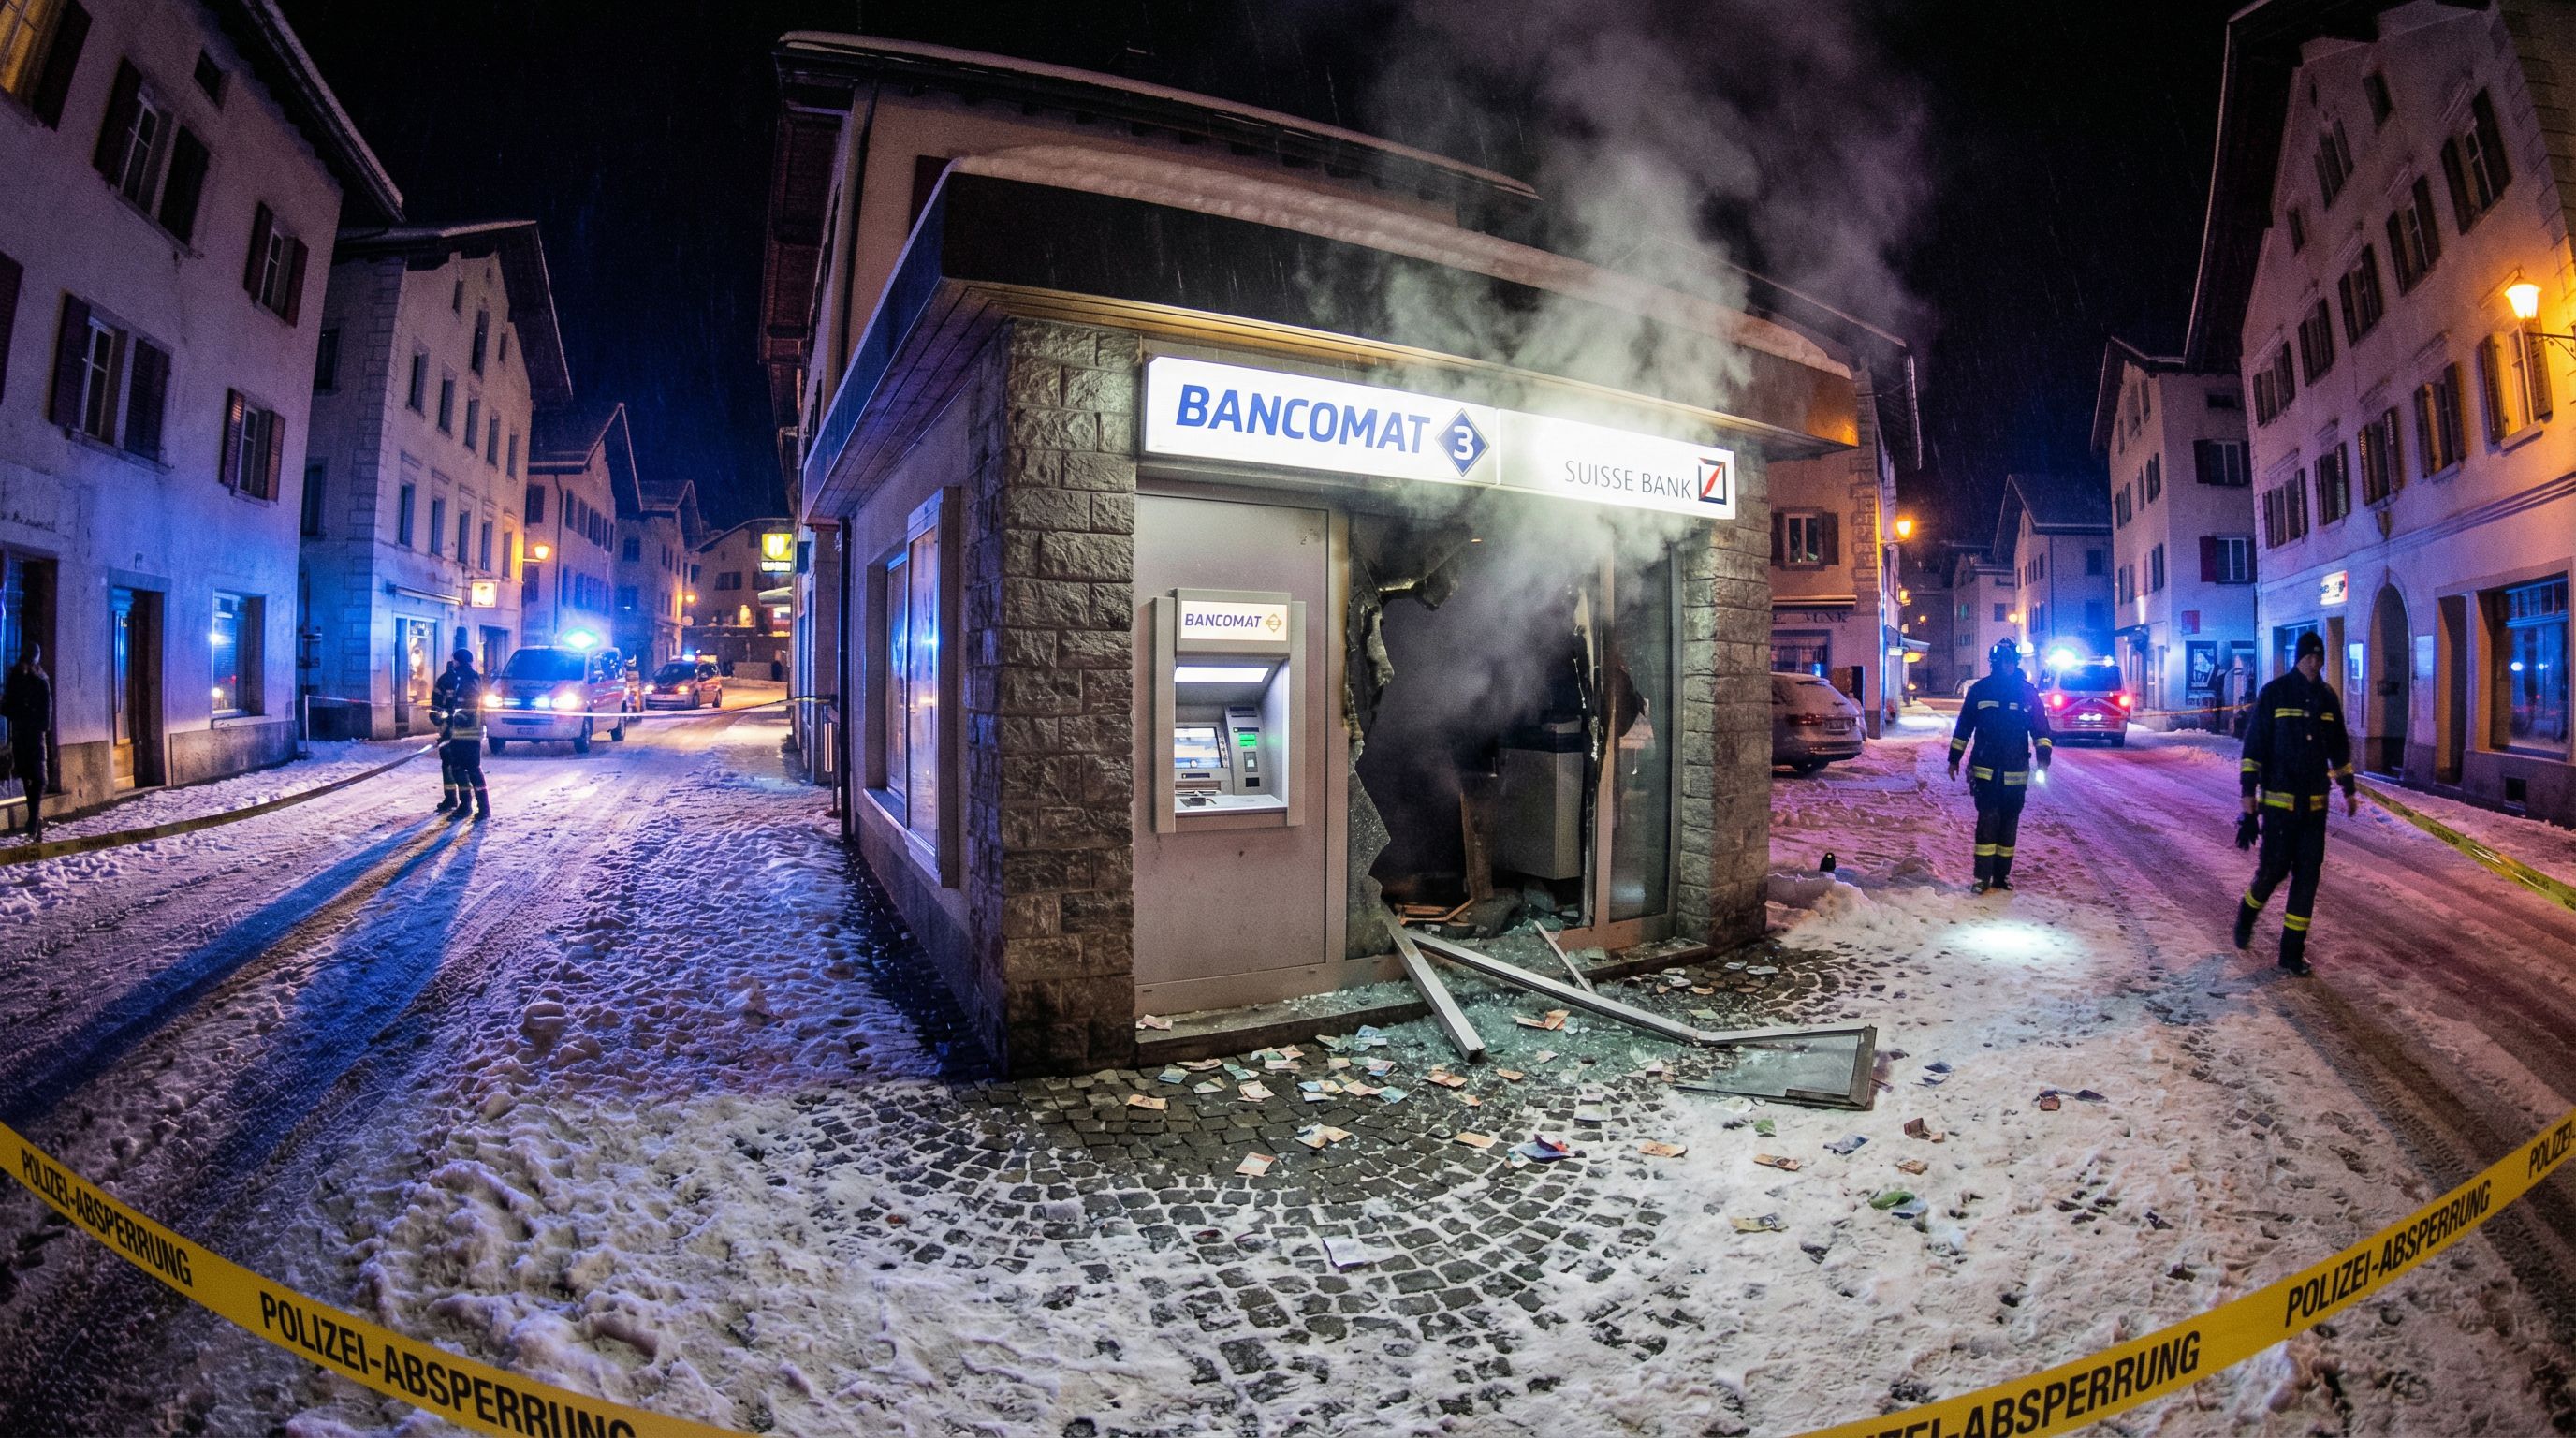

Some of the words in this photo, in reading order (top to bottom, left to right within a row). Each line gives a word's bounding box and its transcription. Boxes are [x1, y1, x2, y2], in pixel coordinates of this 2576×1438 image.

[1176, 384, 1430, 454] BANCOMAT
[1452, 425, 1474, 461] 3
[1565, 460, 1633, 492] SUISSE
[1642, 473, 1691, 500] BANK
[1185, 613, 1262, 628] BANCOMAT
[21, 1148, 193, 1287] POLIZEI-ABSPERRUNG
[2285, 1179, 2492, 1328] POLIZEI-ABSPERRUNG
